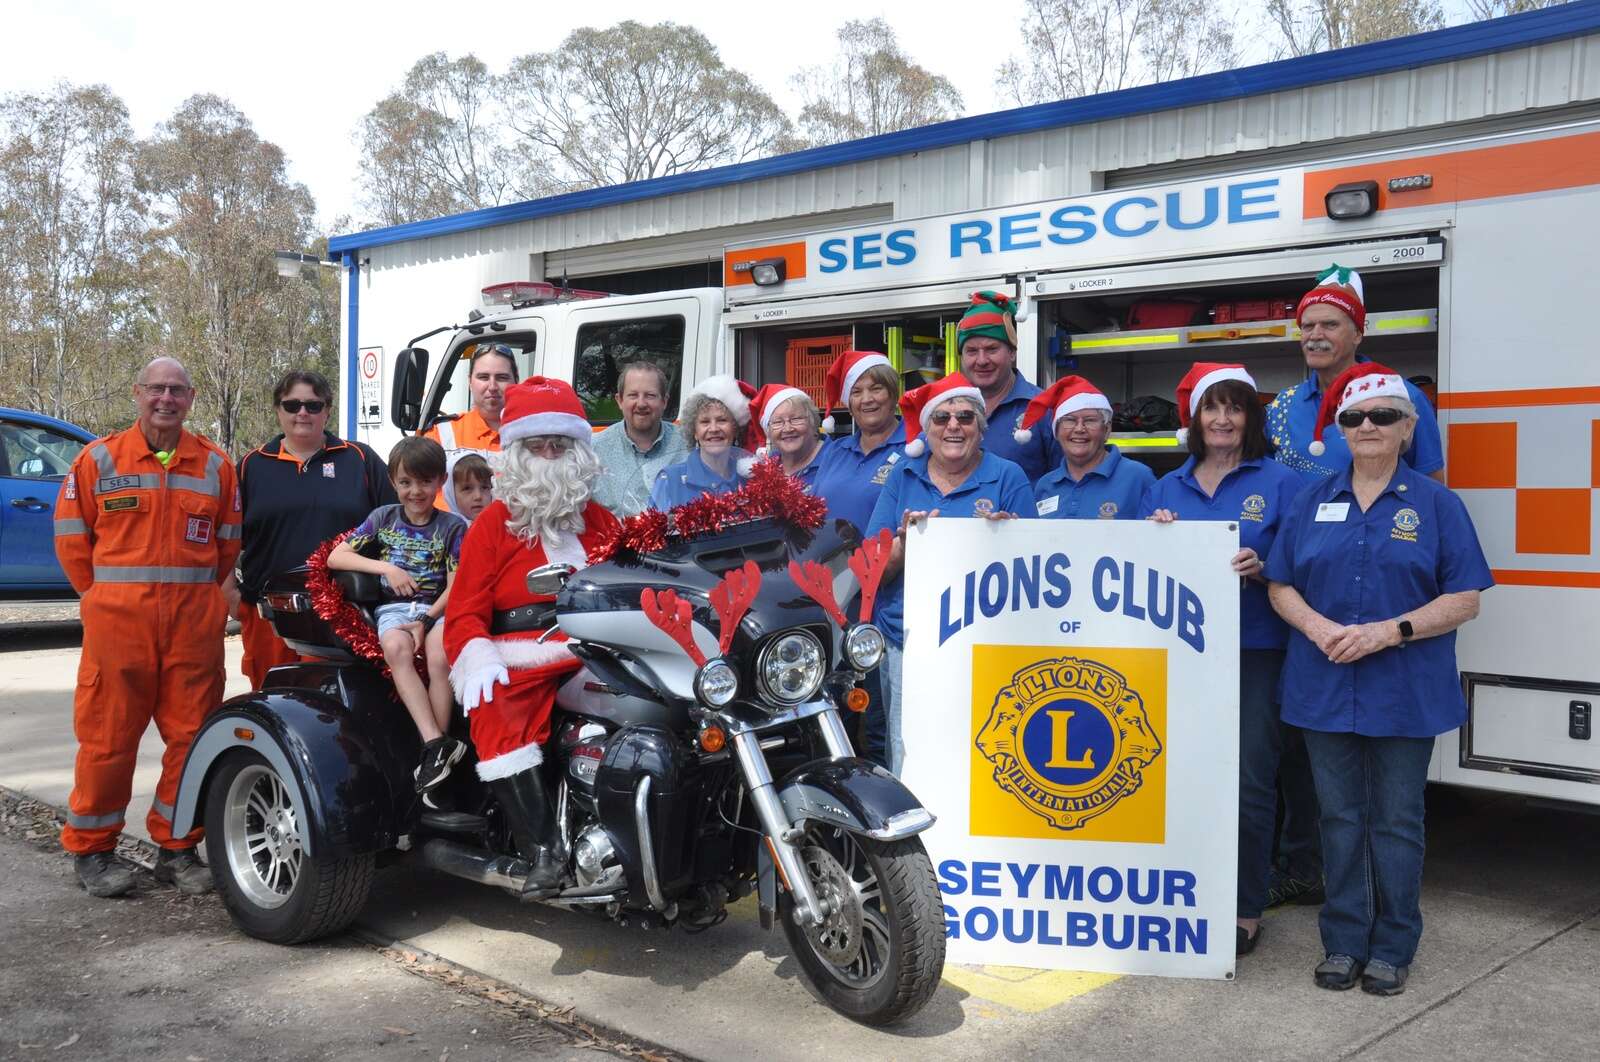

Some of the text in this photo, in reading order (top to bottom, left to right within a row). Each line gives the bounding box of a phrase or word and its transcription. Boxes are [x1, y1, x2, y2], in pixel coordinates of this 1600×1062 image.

[820, 178, 1280, 273] SES RESCUE
[1393, 246, 1425, 258] 2000
[1079, 279, 1107, 288] LOCKER
[763, 310, 784, 318] LOCKER
[367, 359, 374, 371] 10
[110, 478, 130, 488] SES
[938, 552, 1205, 653] LIONS CLUB
[1060, 621, 1081, 633] OF
[1021, 666, 1117, 698] LIONS
[1045, 709, 1095, 769] L
[1009, 771, 1128, 811] INTERNATIONAL
[937, 859, 1197, 907] SEYMOUR
